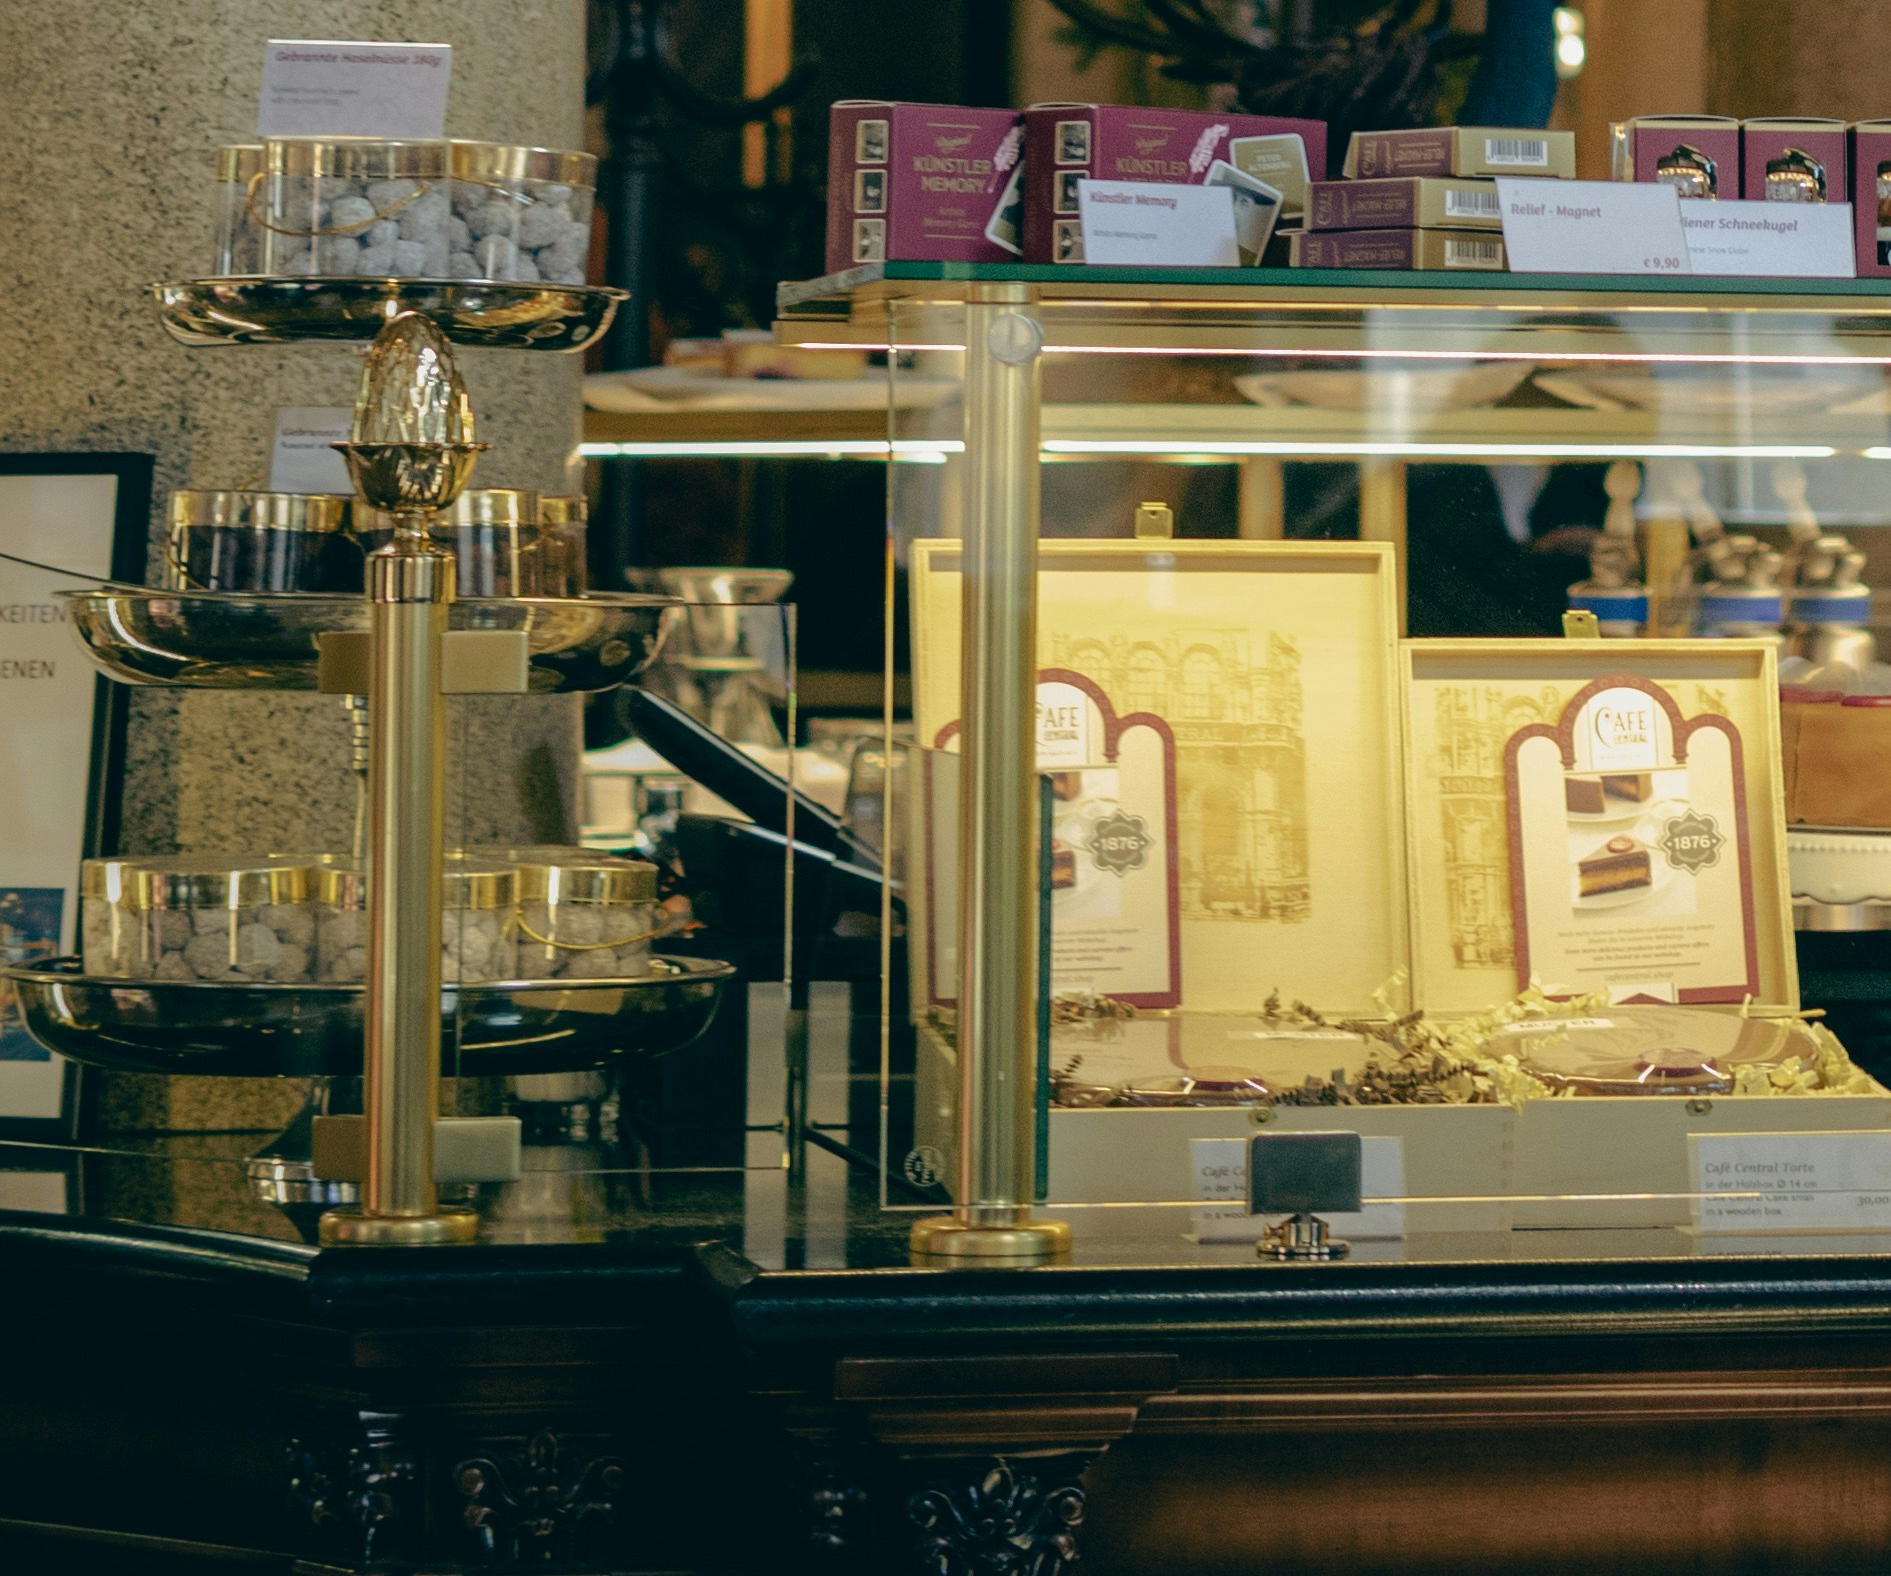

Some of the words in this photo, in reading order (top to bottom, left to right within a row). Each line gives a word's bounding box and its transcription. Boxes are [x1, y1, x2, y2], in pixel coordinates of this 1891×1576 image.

[913, 155, 992, 175] KÜNSTLER
[1115, 155, 1188, 177] KÜNSTLER
[1090, 191, 1133, 205] Künstler
[1135, 194, 1178, 210] Memory
[1511, 203, 1545, 215] Relief
[1556, 204, 1602, 219] Magnet
[1681, 217, 1716, 229] iener
[1719, 218, 1798, 233] Schneekugel
[1653, 257, 1680, 271] 9,90
[1099, 836, 1139, 851] 1876
[1673, 835, 1711, 851] 1876
[1705, 1163, 1731, 1176] Café
[1734, 1162, 1778, 1173] Central
[1782, 1162, 1815, 1173] Torte
[1705, 1180, 1716, 1188] in
[1717, 1180, 1732, 1188] der
[1735, 1179, 1774, 1188] Holzbox
[1789, 1180, 1802, 1188] 14
[1857, 1196, 1890, 1207] 30,00
[1705, 1207, 1716, 1215] in
[1725, 1207, 1762, 1215] wooden
[1764, 1206, 1782, 1215] box
